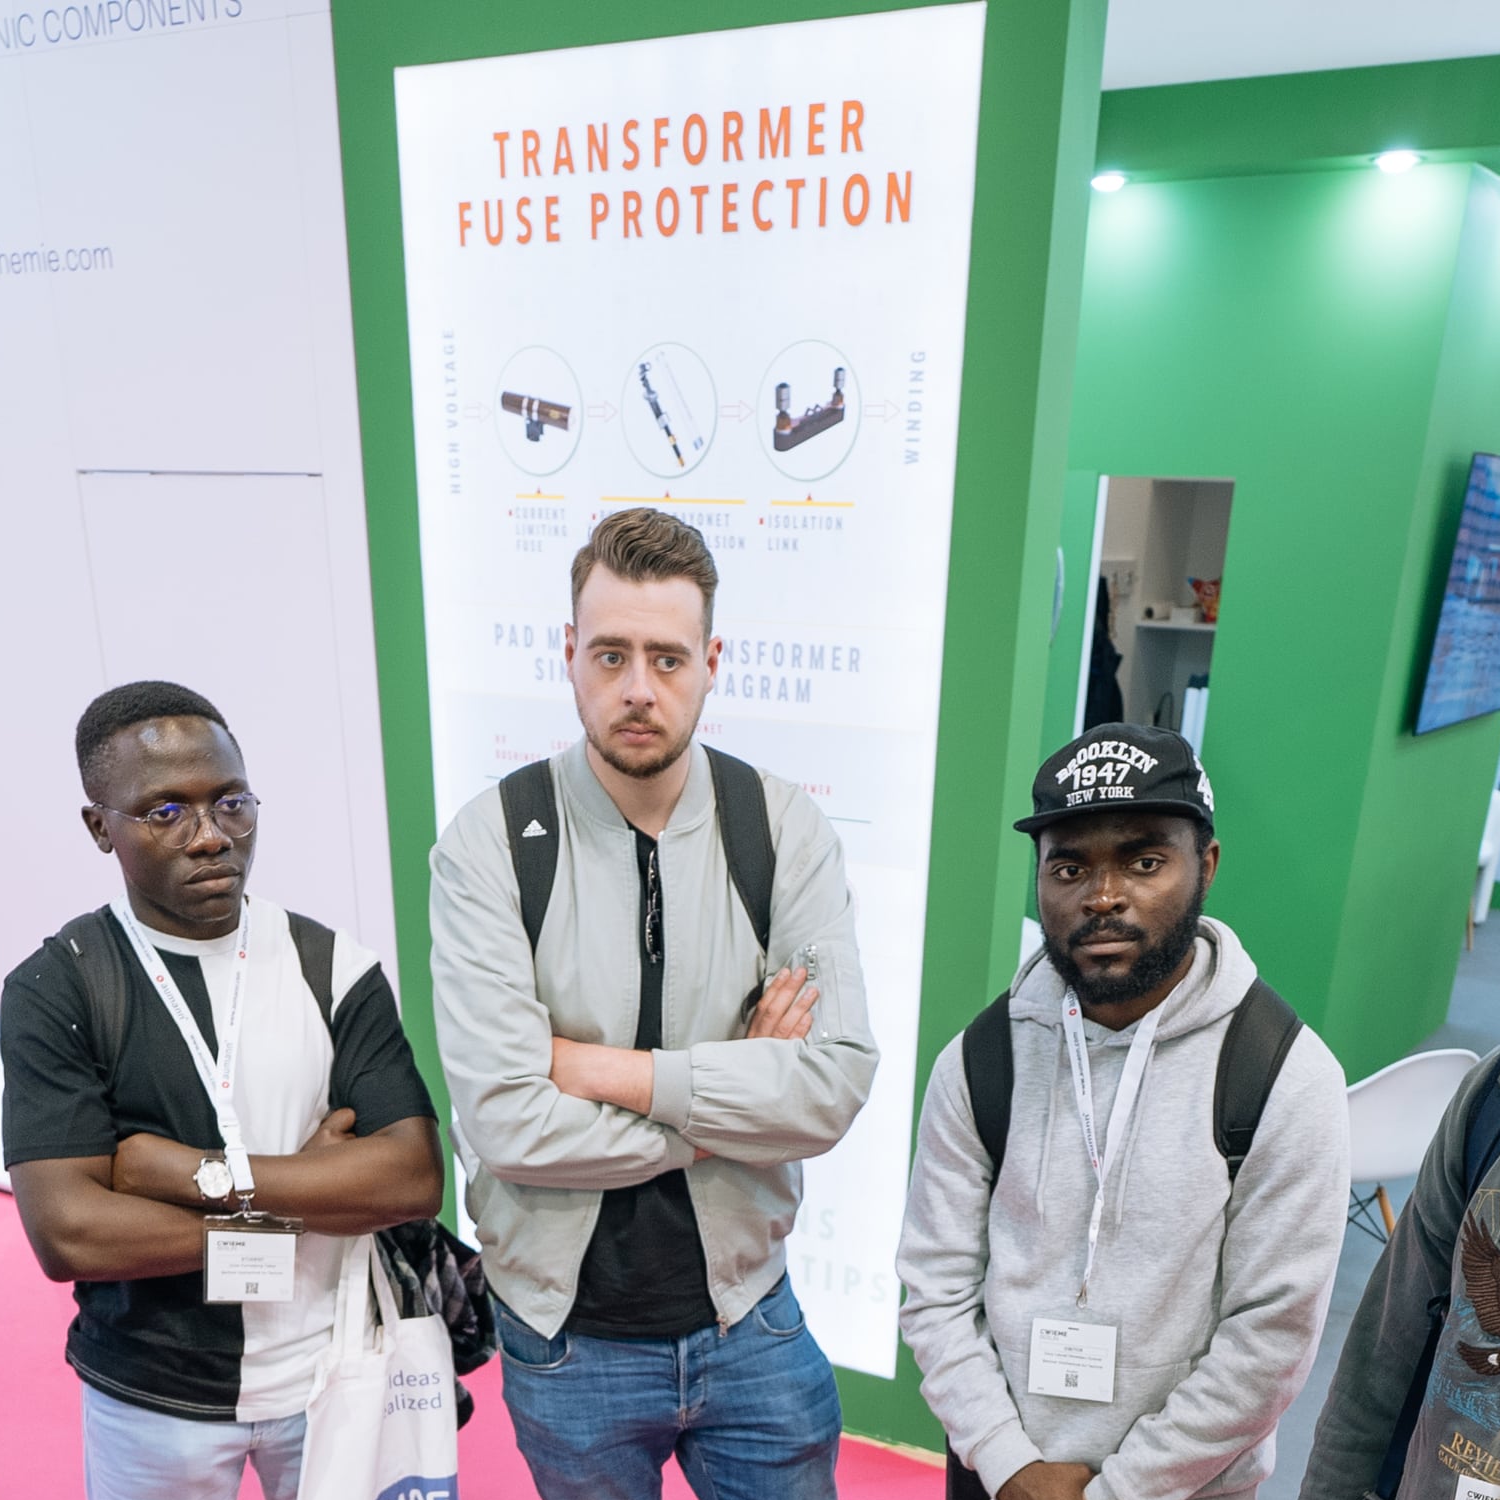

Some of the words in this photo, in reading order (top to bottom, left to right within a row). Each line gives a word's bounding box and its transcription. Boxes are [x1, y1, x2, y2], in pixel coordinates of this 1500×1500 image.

[493, 100, 866, 179] TRANSFORMER
[458, 195, 562, 247] FUSE
[590, 170, 913, 240] PROTECTION
[443, 328, 459, 429] VOLTAGE
[904, 350, 926, 465] WINDING
[448, 441, 461, 494] HIGH
[515, 506, 566, 521] CURRENT
[767, 513, 844, 531] ISOLATION
[767, 537, 800, 551] LINK
[494, 623, 534, 648] PAD
[1055, 740, 1159, 785] BROOKLYN
[1071, 762, 1131, 791] 1947
[1066, 787, 1096, 807] NEW
[1097, 786, 1135, 800] YORK
[388, 1369, 441, 1389] Ideas
